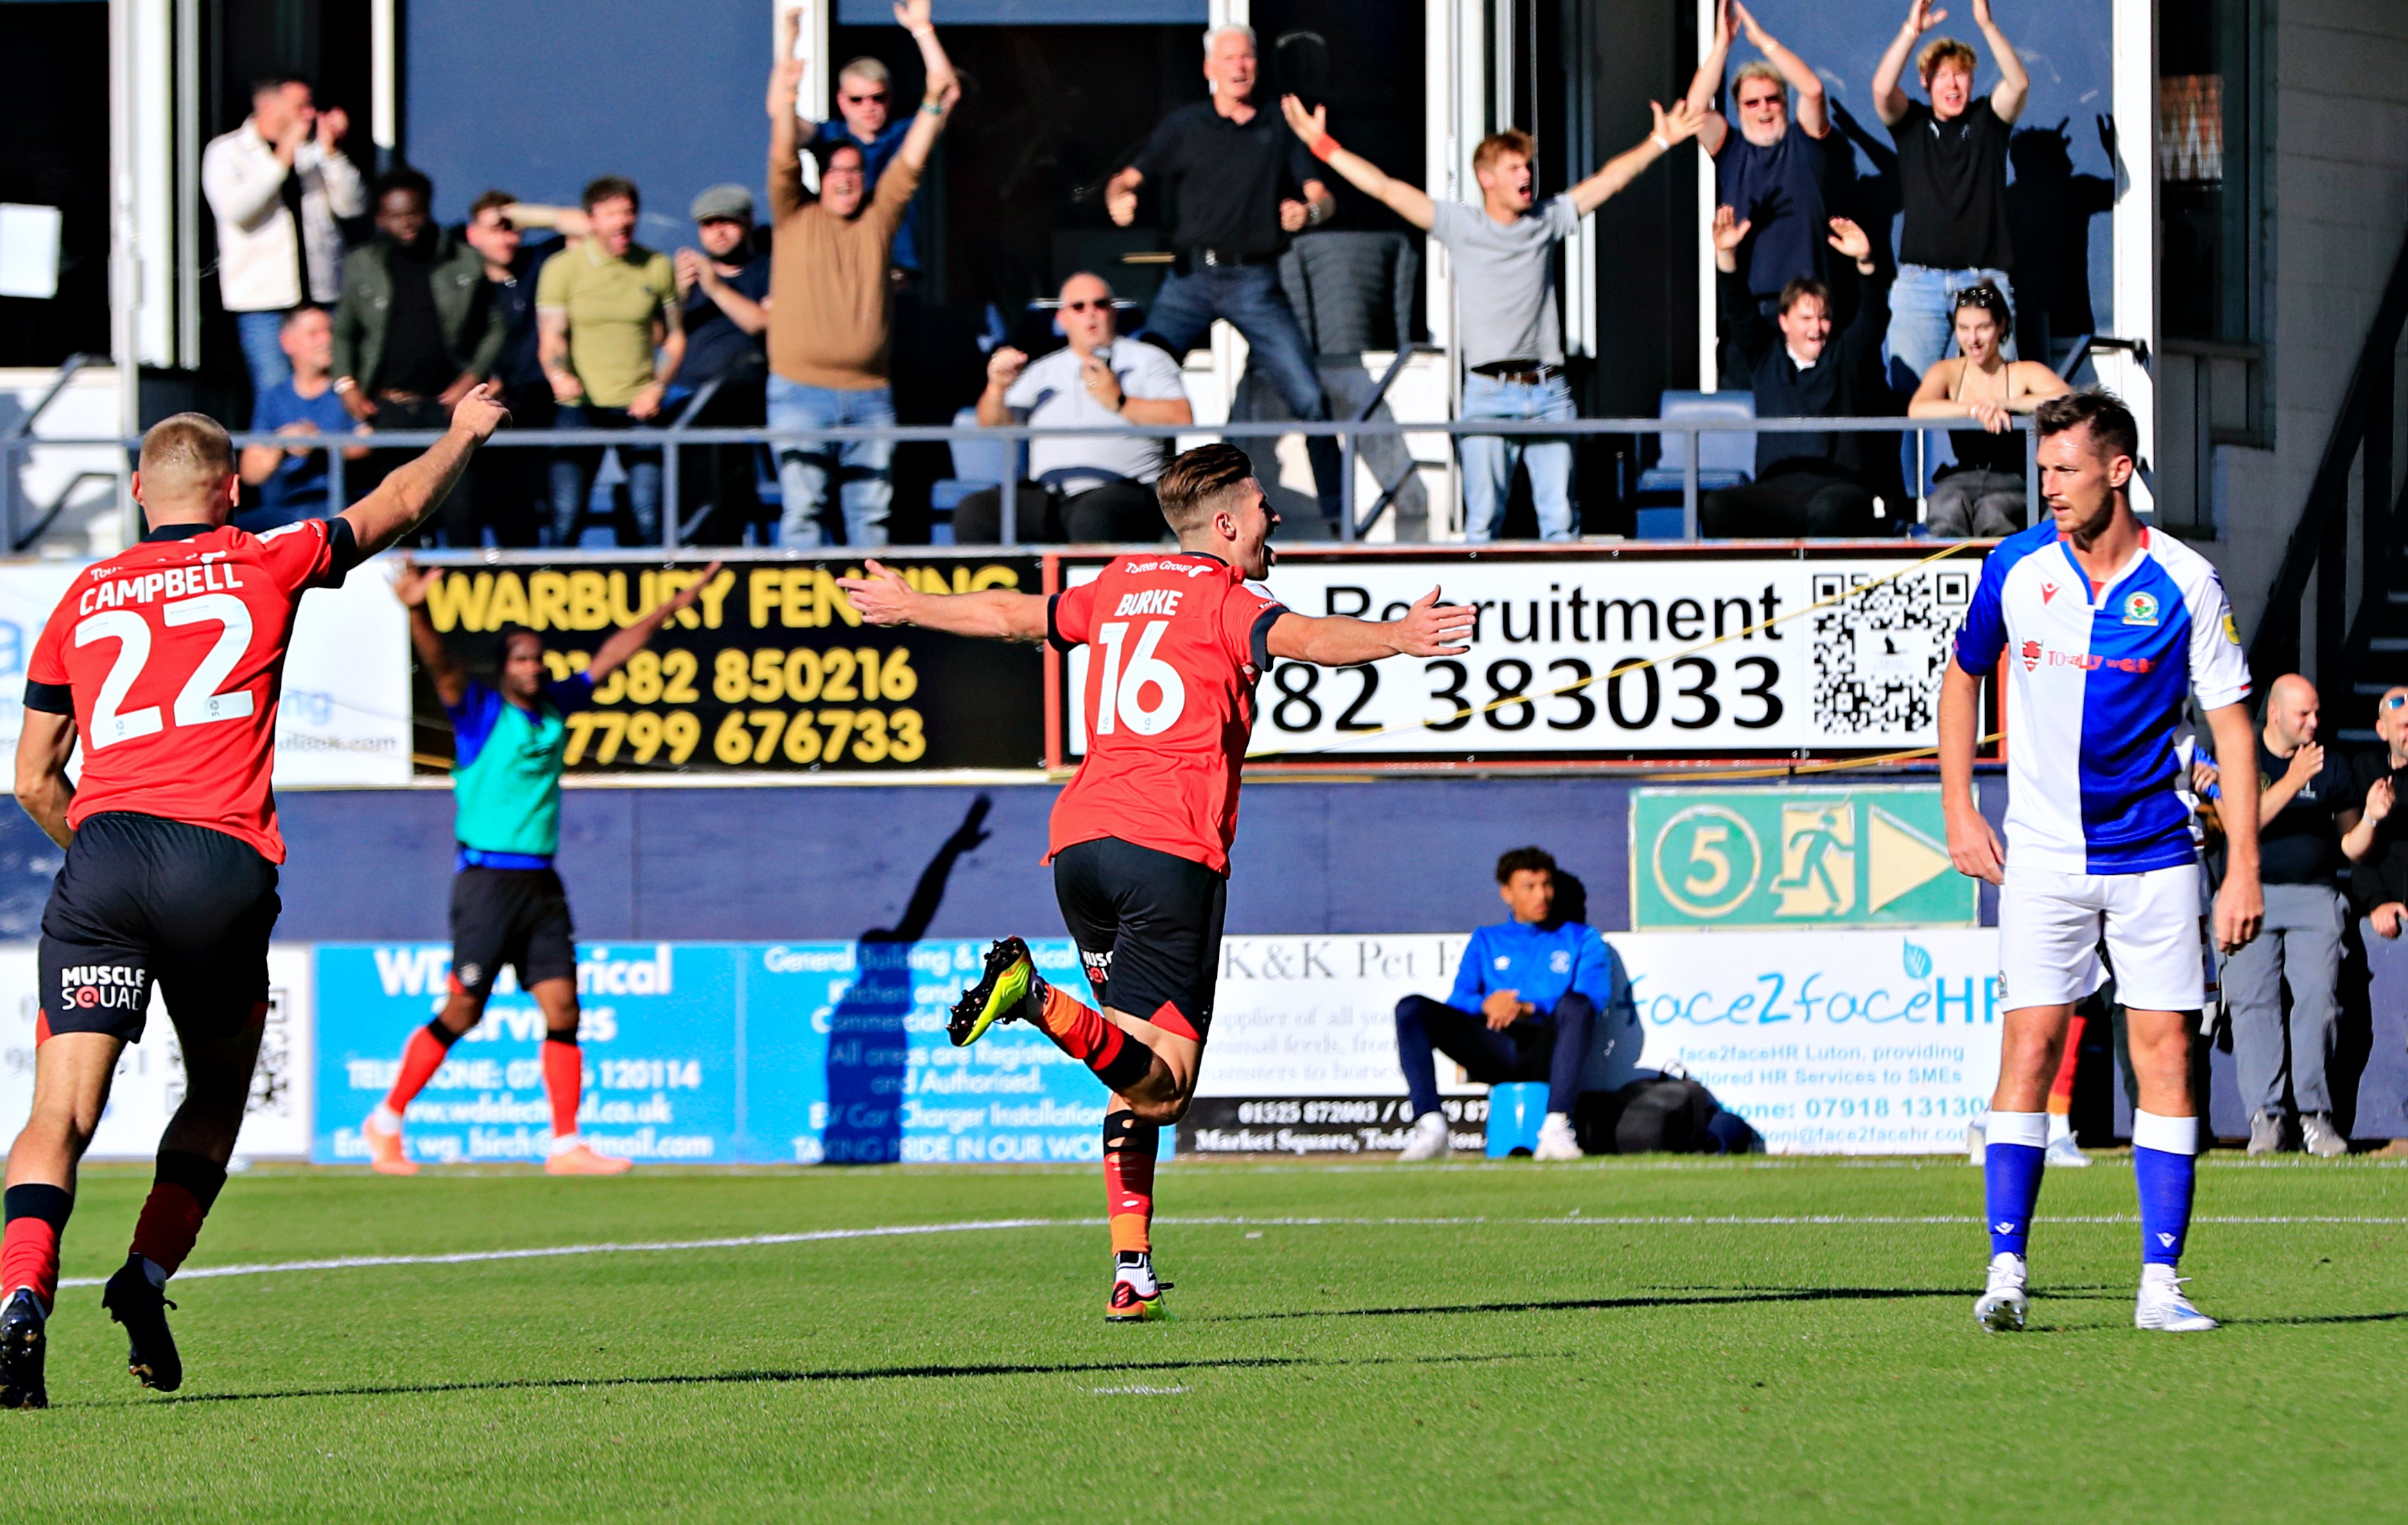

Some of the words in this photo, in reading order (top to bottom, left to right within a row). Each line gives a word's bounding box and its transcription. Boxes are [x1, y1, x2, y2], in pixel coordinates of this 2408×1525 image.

[1159, 560, 1193, 573] Group
[79, 562, 243, 616] CAMPBELL
[426, 569, 736, 632] WARBURY
[1114, 589, 1184, 616] BURKE
[74, 592, 254, 749] 22
[713, 647, 918, 704] 850216
[1096, 620, 1186, 736] 16
[1423, 656, 1785, 733] 383033
[713, 708, 927, 765] 676733
[1684, 825, 1732, 898] 5
[763, 942, 858, 973] General
[953, 943, 975, 969] &
[1222, 939, 1335, 982] K&K
[1354, 940, 1422, 981] Pet
[60, 966, 146, 988] MUSCLE
[912, 976, 962, 1005] and
[829, 1039, 863, 1067] All
[864, 1046, 930, 1067] areas
[930, 1046, 971, 1067] are
[1679, 1044, 1799, 1063] face2faceHR
[1806, 1045, 1867, 1063] Luton,
[1873, 1043, 1966, 1065] providing
[599, 1058, 702, 1090] 120114
[870, 1065, 919, 1095] and
[919, 1064, 1048, 1095] Authorised.
[1760, 1068, 1789, 1086] HR
[1796, 1068, 1876, 1086] Services
[1883, 1068, 1902, 1085] to
[1908, 1068, 1963, 1086] SMEs
[847, 1101, 891, 1128] Car
[893, 1099, 988, 1135] Charger
[1805, 1096, 1891, 1119] 07918
[1901, 1096, 1986, 1119] 13130
[887, 1133, 953, 1162] PRIDE
[954, 1135, 986, 1162] IN
[987, 1133, 1045, 1162] OUR
[1194, 1128, 1276, 1152] Market
[1276, 1127, 1360, 1156] Square,
